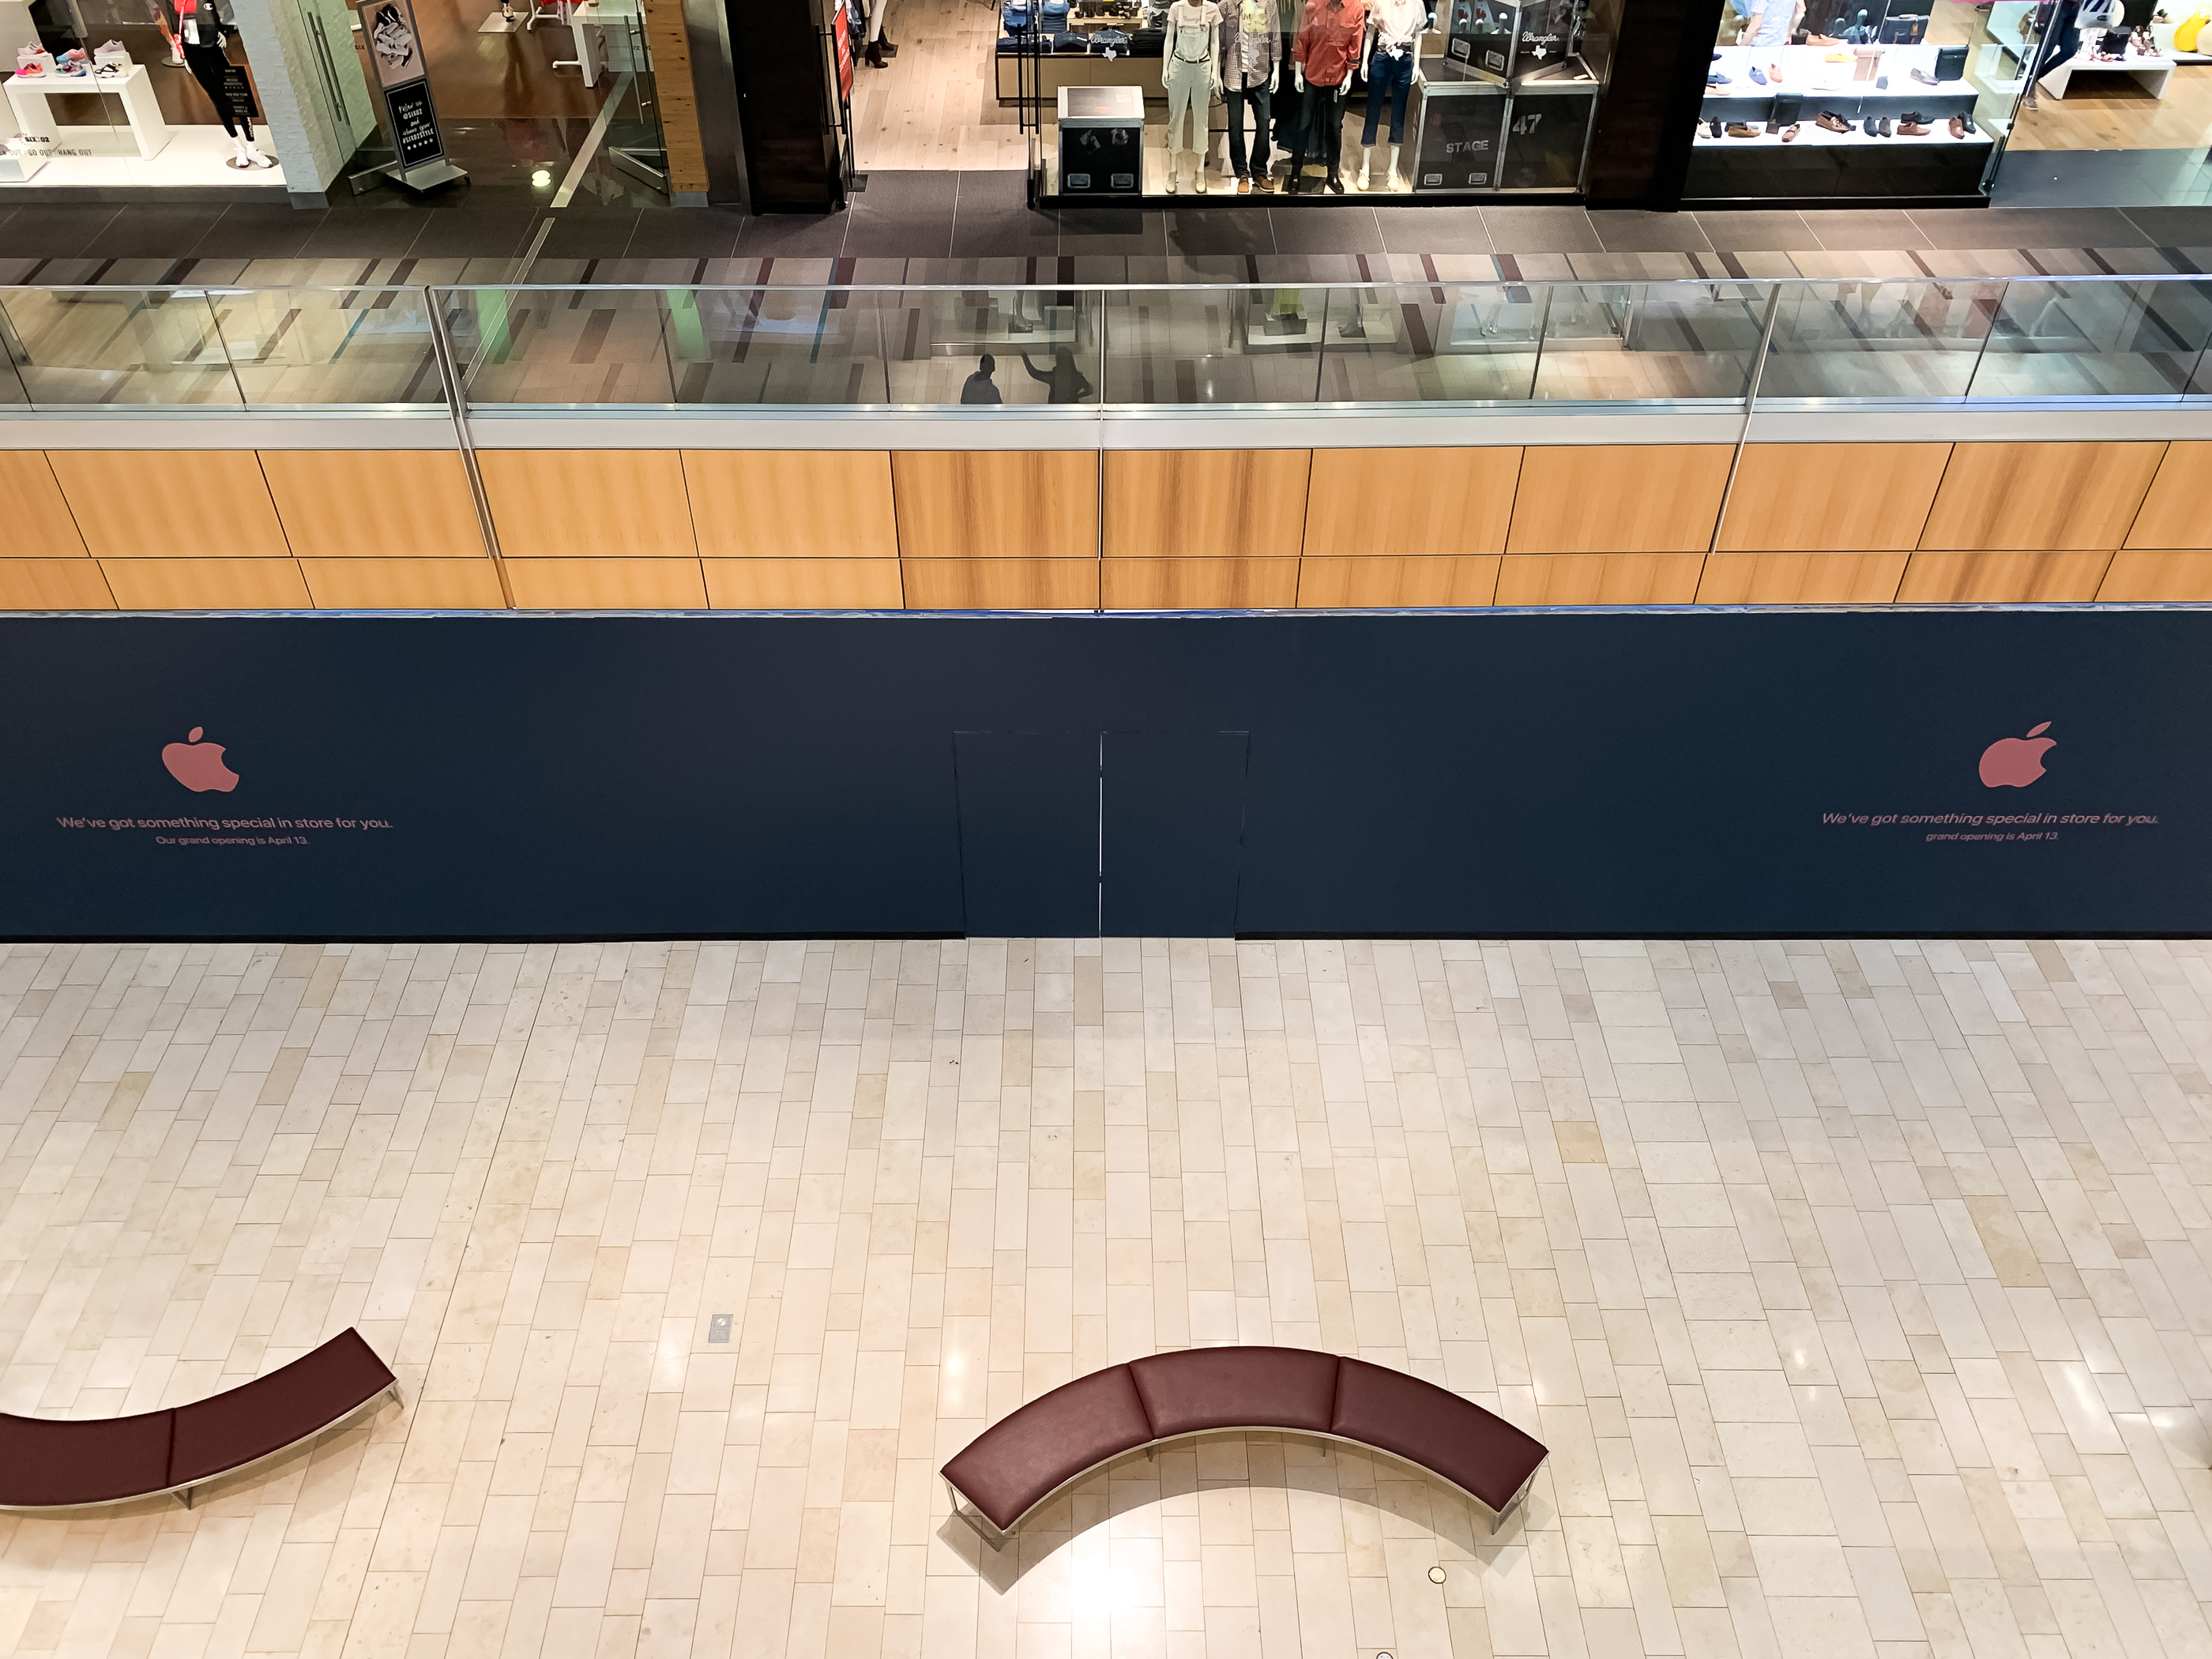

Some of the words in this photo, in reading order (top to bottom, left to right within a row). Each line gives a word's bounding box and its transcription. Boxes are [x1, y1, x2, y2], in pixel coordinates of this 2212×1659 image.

[1090, 33, 1129, 47] Wrangler
[1522, 31, 1559, 45] Wrangler
[1513, 114, 1542, 135] 47
[1446, 140, 1489, 153] STAGE
[57, 817, 106, 828] We've
[109, 818, 135, 830] got
[137, 817, 220, 830] something
[222, 817, 276, 830] special
[278, 817, 292, 828] in
[295, 818, 334, 828] store
[336, 817, 356, 828] for
[359, 818, 393, 830] you.
[1823, 813, 1869, 824] We've
[1870, 814, 1898, 826] got
[1900, 812, 1983, 826] something
[1985, 812, 2042, 826] special
[2042, 813, 2058, 824] in
[2060, 814, 2101, 824] store
[2102, 813, 2126, 824] for
[2125, 815, 2158, 826] you.
[156, 836, 175, 845] Our
[179, 836, 210, 845] grand
[212, 836, 255, 846] opening
[257, 836, 266, 845] is
[268, 836, 292, 846] April
[1925, 833, 1958, 842] grand
[1959, 833, 2004, 842] opening
[2016, 832, 2043, 841] April
